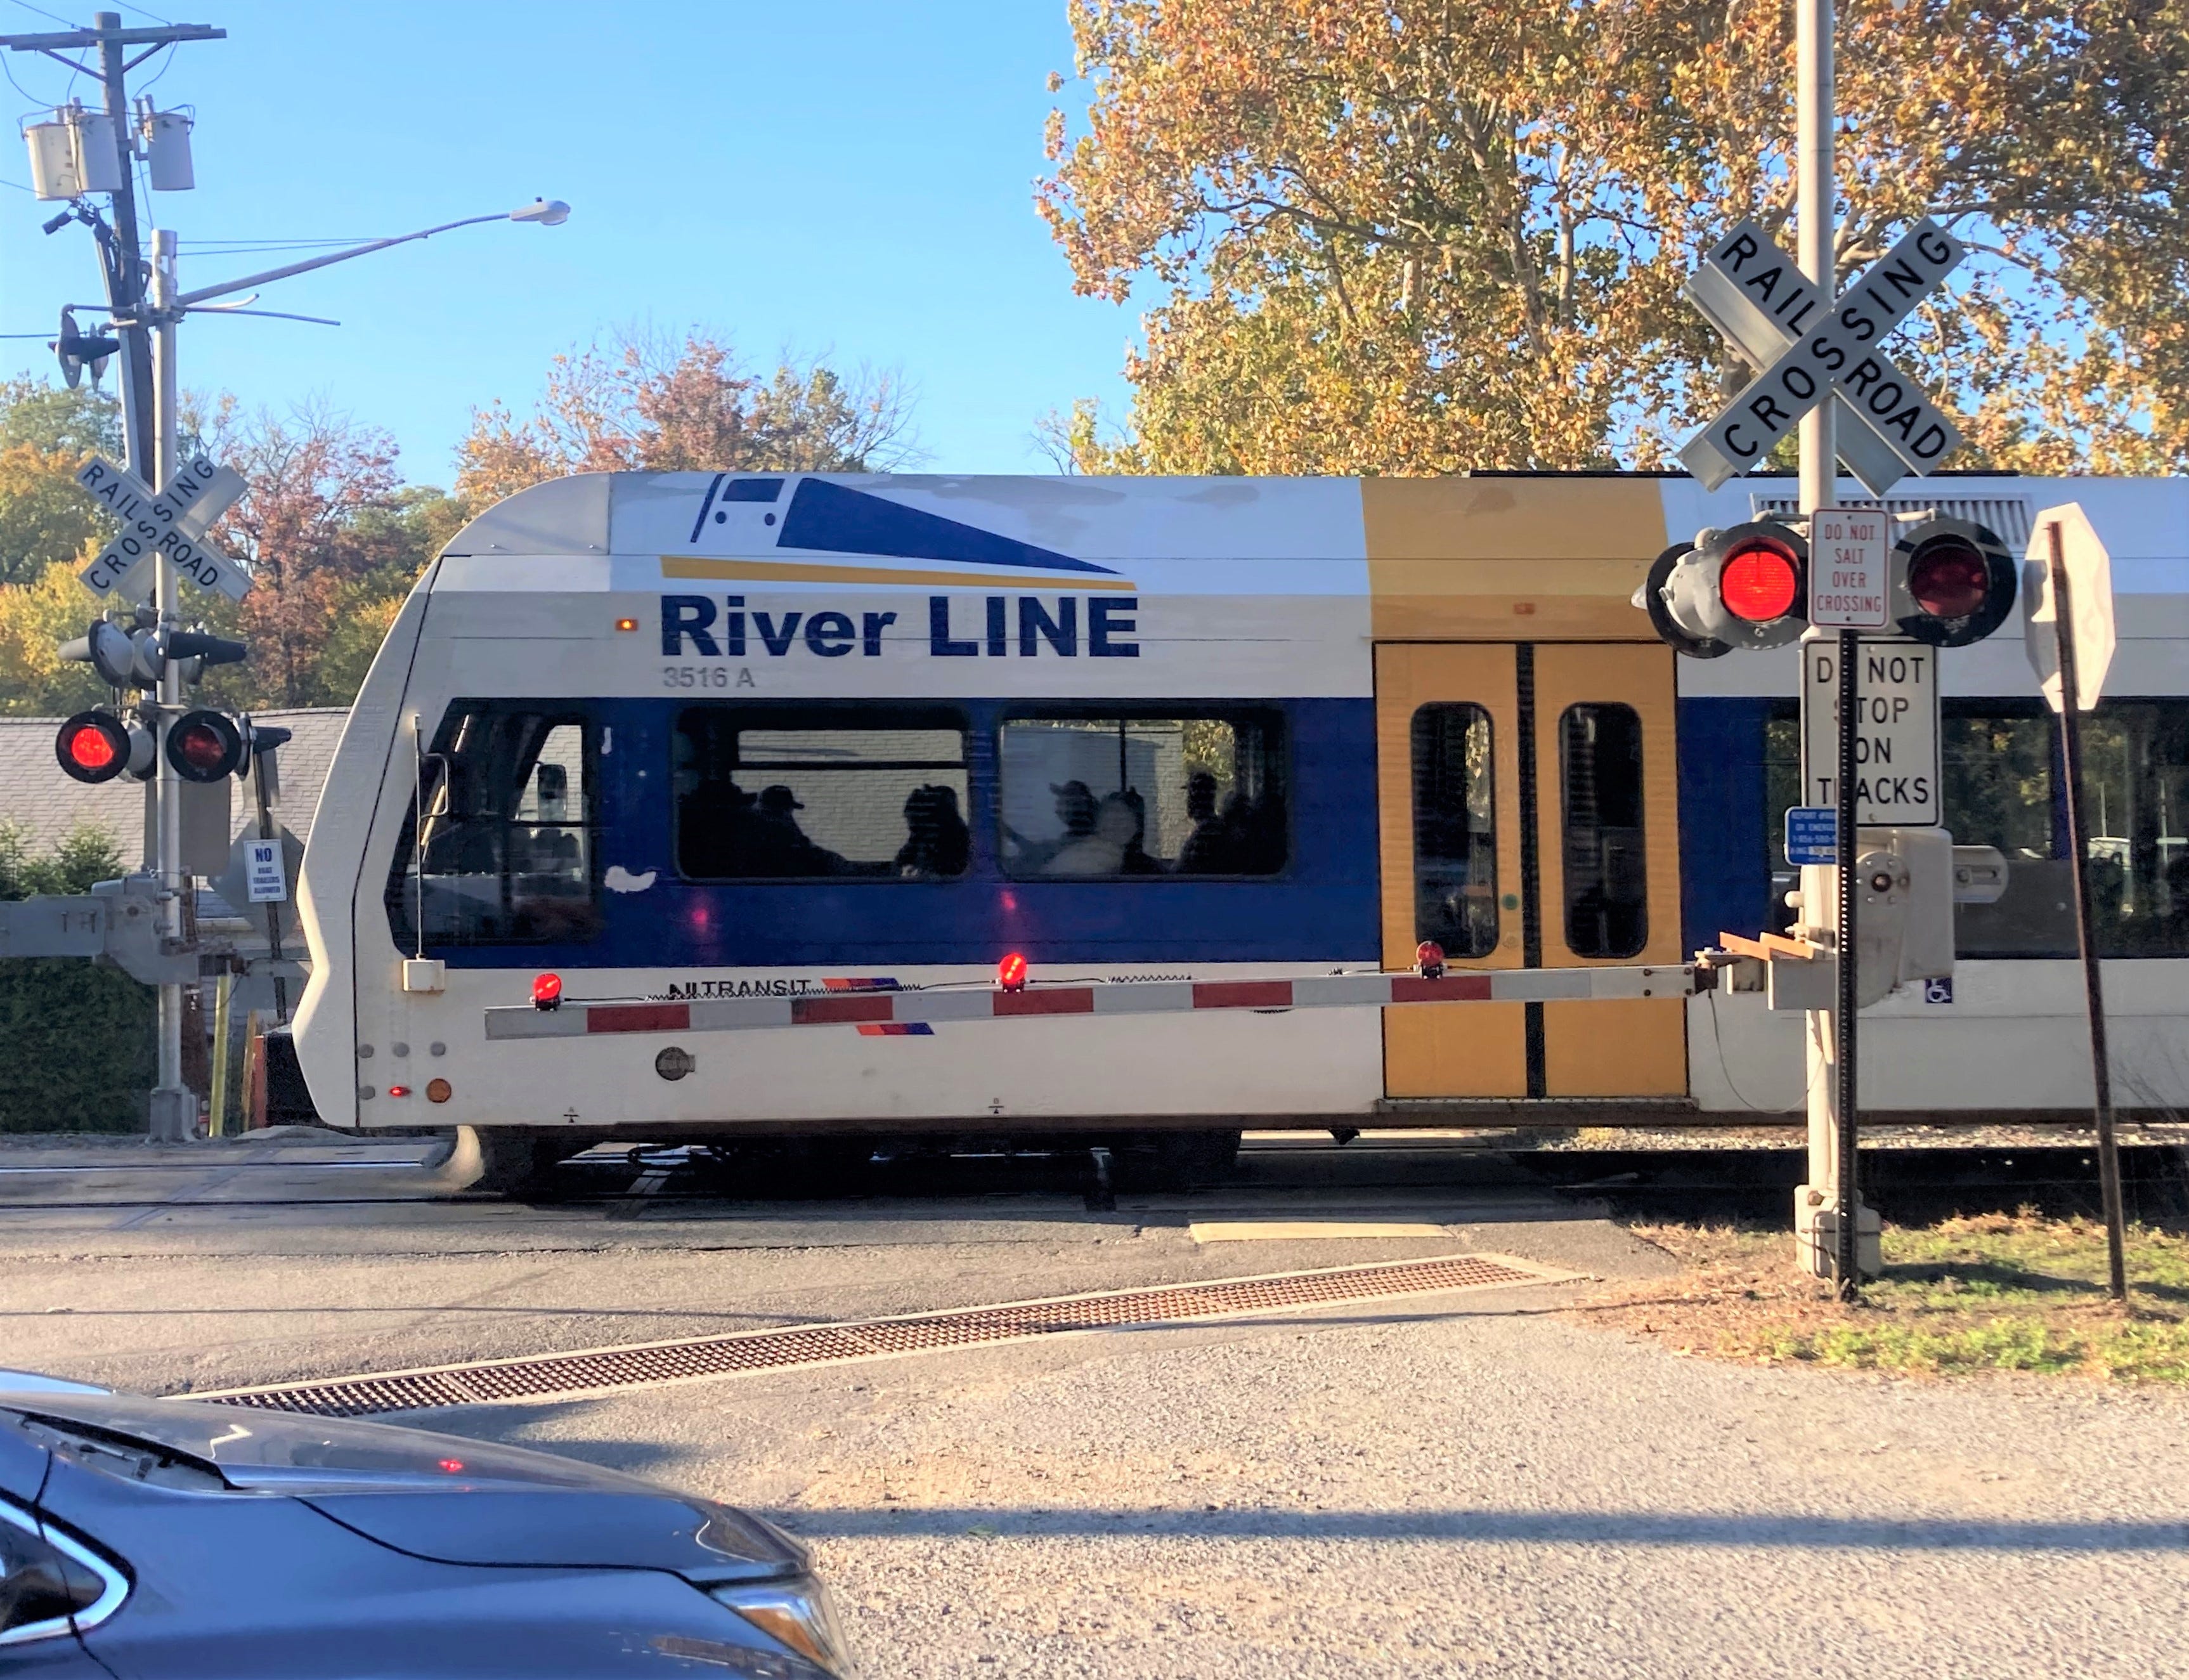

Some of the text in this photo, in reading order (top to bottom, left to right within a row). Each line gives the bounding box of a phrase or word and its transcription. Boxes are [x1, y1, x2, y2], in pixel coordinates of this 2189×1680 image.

[1719, 232, 1946, 459] RAIL ROAD
[1724, 231, 1951, 457] CROSSING
[82, 464, 218, 587] RAIL ROAD
[89, 460, 214, 590] CROSSING
[1824, 524, 1875, 541] DO NOT
[1834, 548, 1865, 564] SALT
[1832, 571, 1867, 588] OVER
[1816, 595, 1882, 613] CROSSING
[661, 595, 1140, 658] River LINE
[663, 667, 756, 688] 3516 A
[1868, 656, 1925, 684] NOT
[1855, 737, 1892, 764] ON
[255, 847, 273, 863] NO
